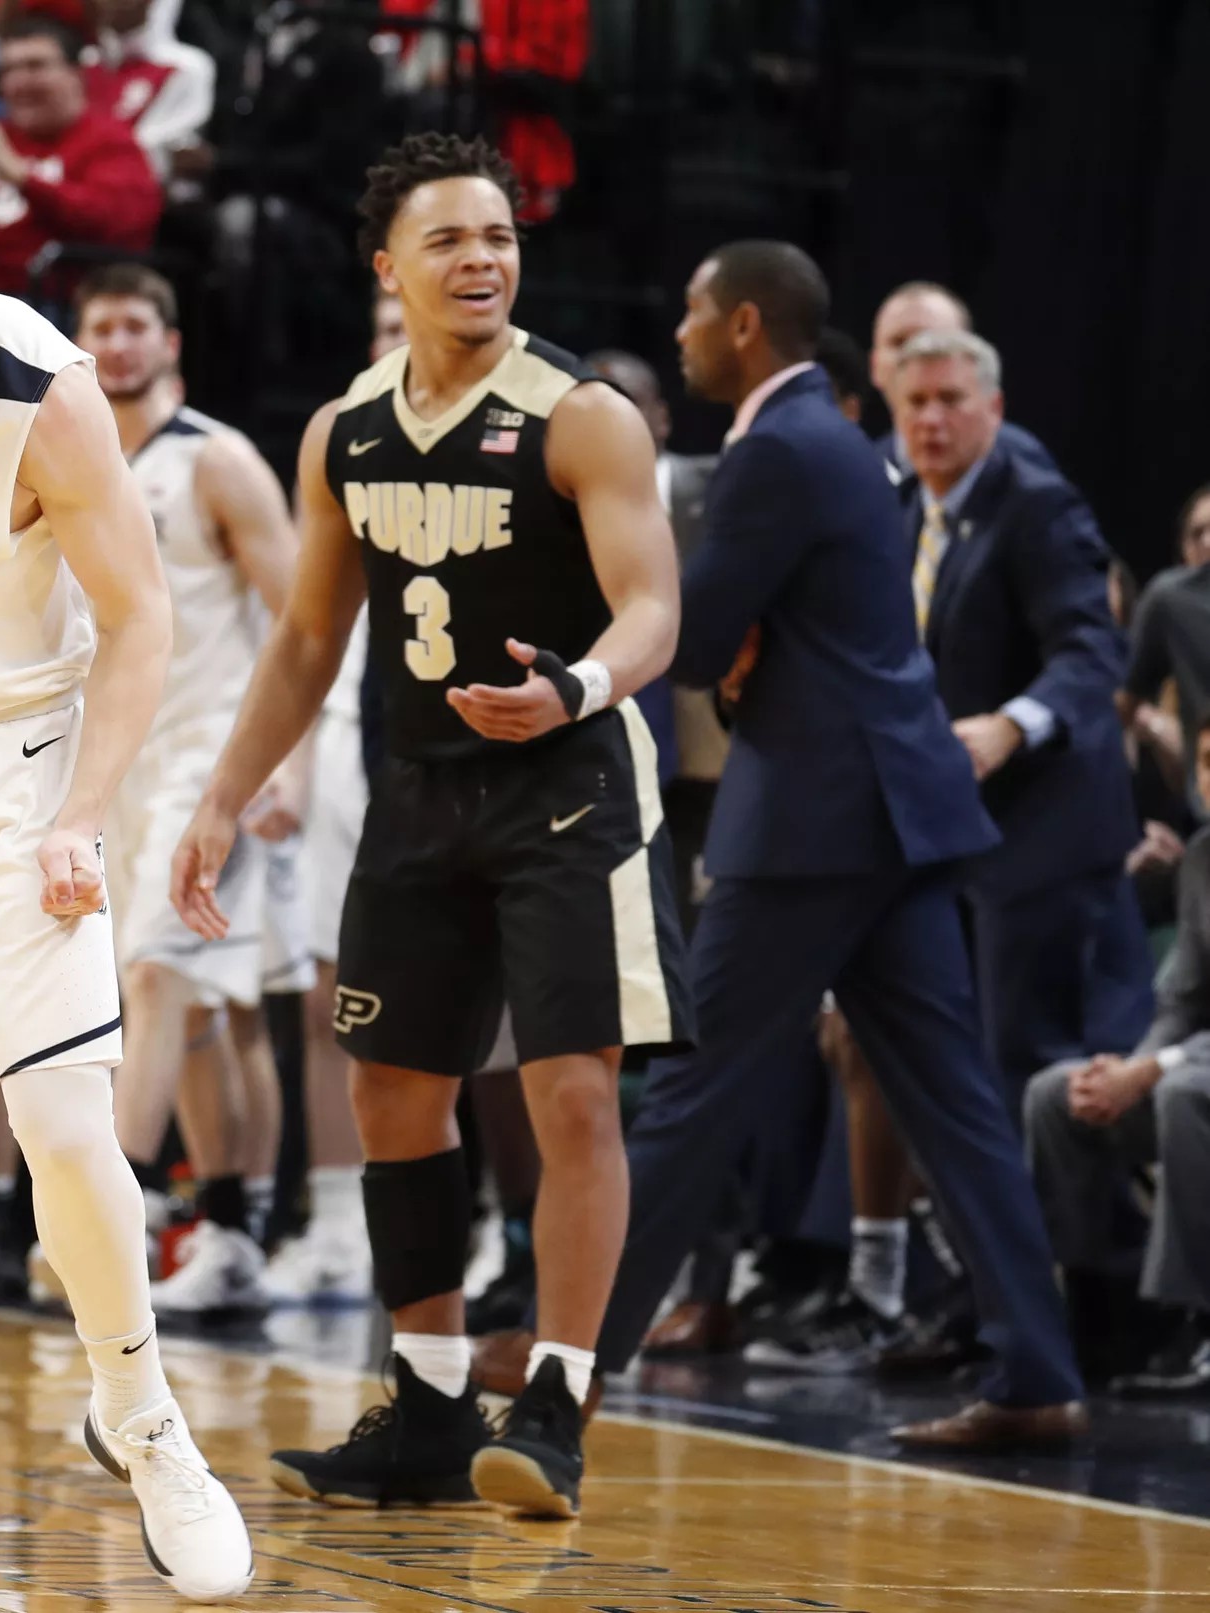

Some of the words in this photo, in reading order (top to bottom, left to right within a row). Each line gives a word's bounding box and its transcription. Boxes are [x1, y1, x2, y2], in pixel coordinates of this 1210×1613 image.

[343, 481, 514, 568] PURDUE
[402, 575, 458, 681] 3
[332, 985, 382, 1033] P
